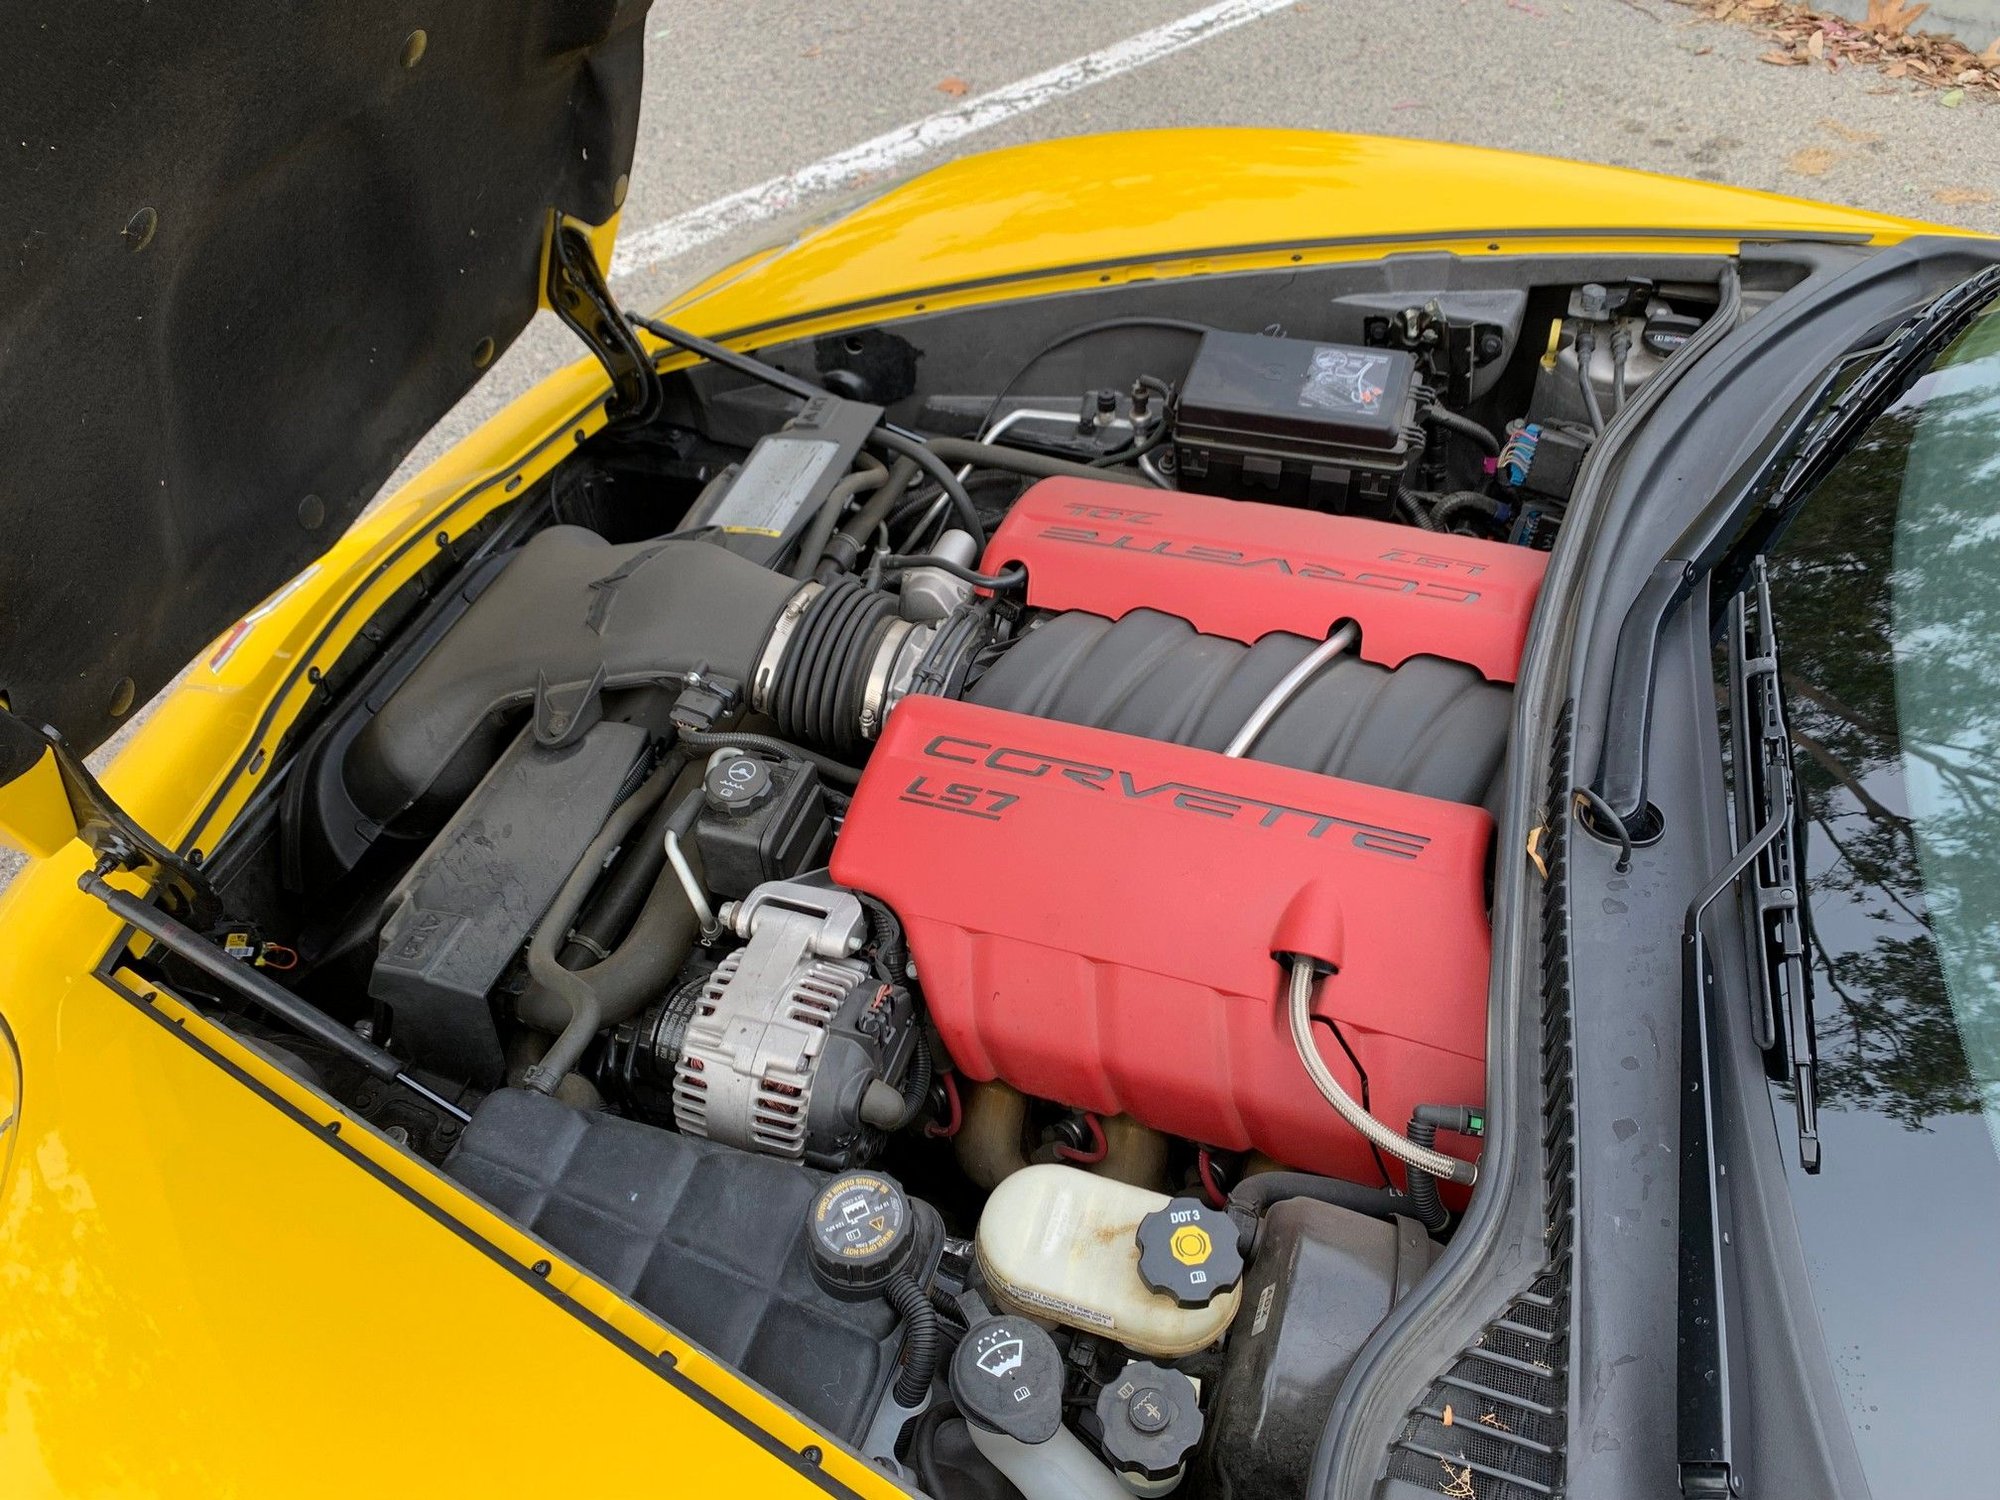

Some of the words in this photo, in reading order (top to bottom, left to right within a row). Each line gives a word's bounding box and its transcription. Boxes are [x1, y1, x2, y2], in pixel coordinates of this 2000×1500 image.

[1037, 526, 1483, 604] CORVETTE
[1378, 548, 1489, 576] LS7
[903, 775, 1020, 815] LS7
[924, 734, 1432, 860] CORVETTE
[1170, 1211, 1191, 1224] DOT
[1191, 1209, 1201, 1222] 3
[843, 1246, 859, 1255] HOT!
[860, 1241, 877, 1255] OPEN
